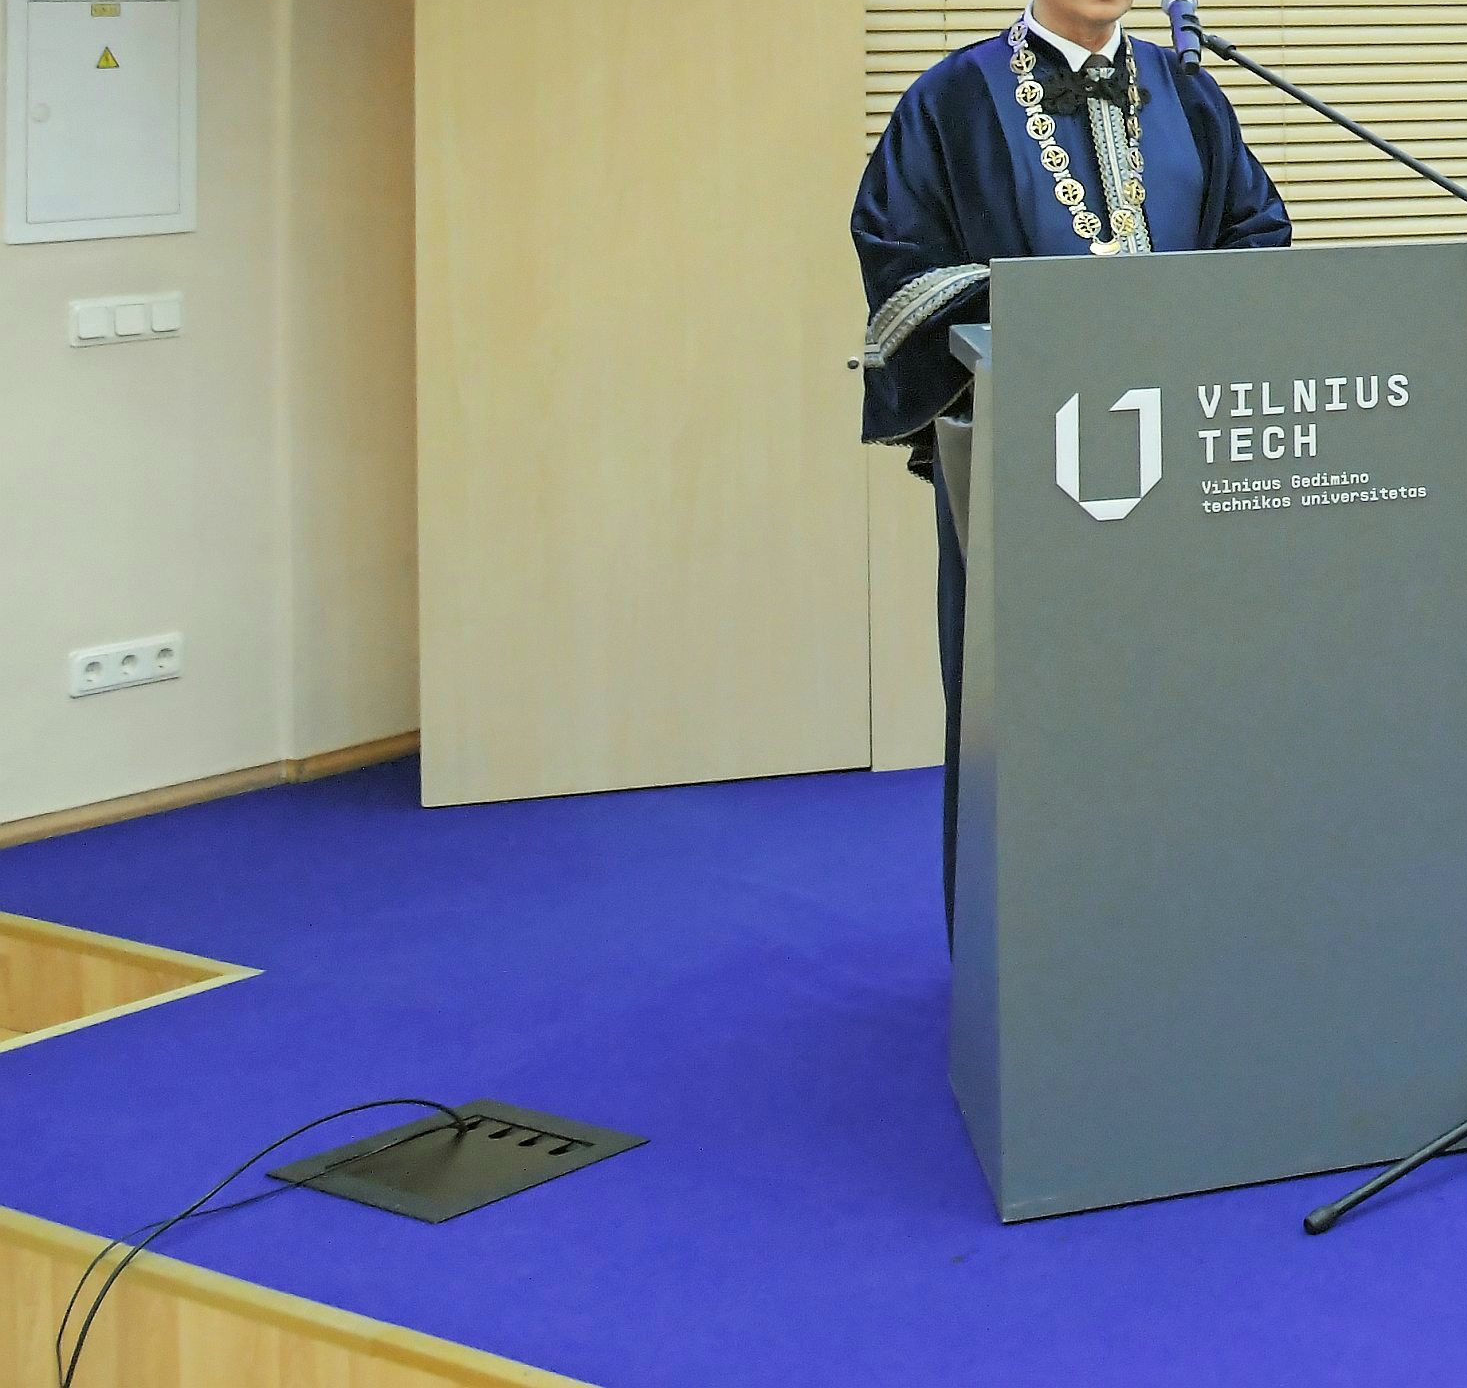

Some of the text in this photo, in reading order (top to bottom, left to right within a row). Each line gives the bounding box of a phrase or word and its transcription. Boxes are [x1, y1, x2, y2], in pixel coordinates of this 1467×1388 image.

[1198, 374, 1409, 419] VILNIUS
[1198, 423, 1317, 464] TECH
[1201, 472, 1369, 495] Vilniaus Gedimino
[1202, 486, 1427, 513] technikos universitetas
